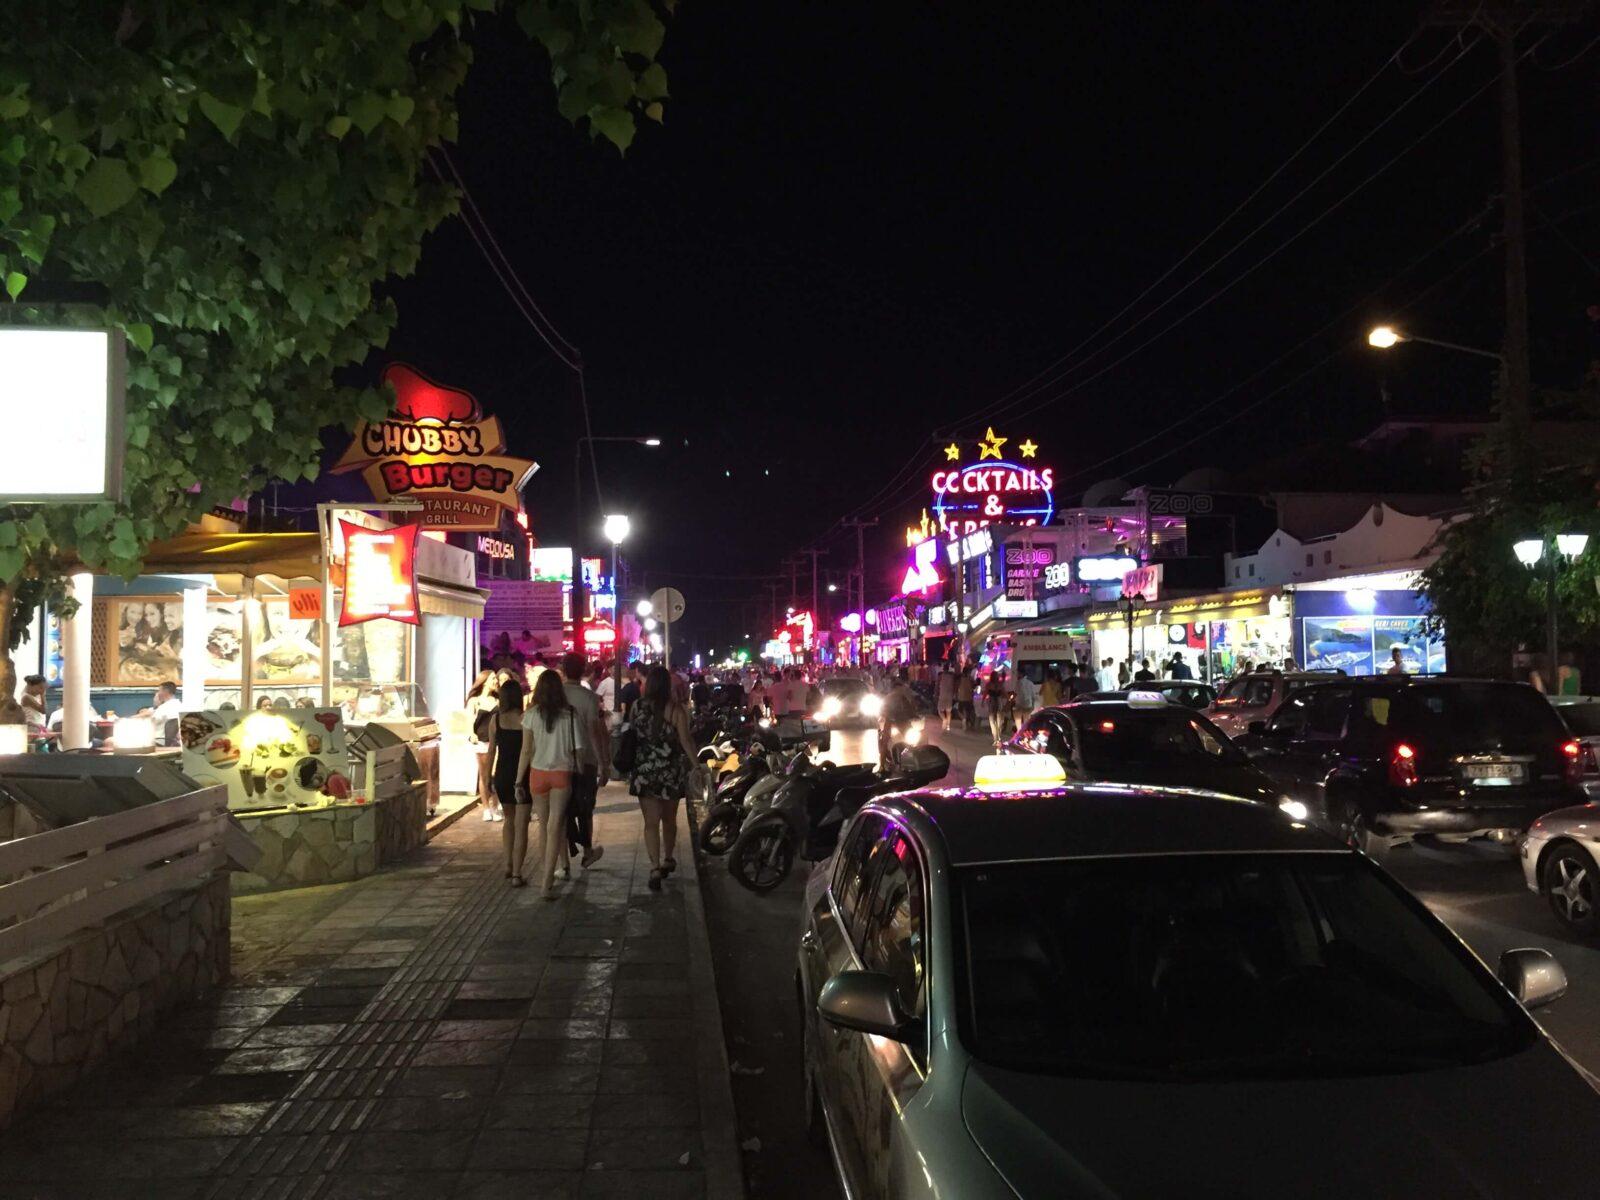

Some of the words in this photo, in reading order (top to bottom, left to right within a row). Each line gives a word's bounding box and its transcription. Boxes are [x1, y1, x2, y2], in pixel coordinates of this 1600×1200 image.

[364, 423, 482, 455] CHUBBY
[382, 461, 512, 493] Burger
[984, 494, 1003, 516] &
[1150, 494, 1213, 513] ZOO
[426, 514, 460, 524] GRILL
[1006, 549, 1054, 565] ZOO
